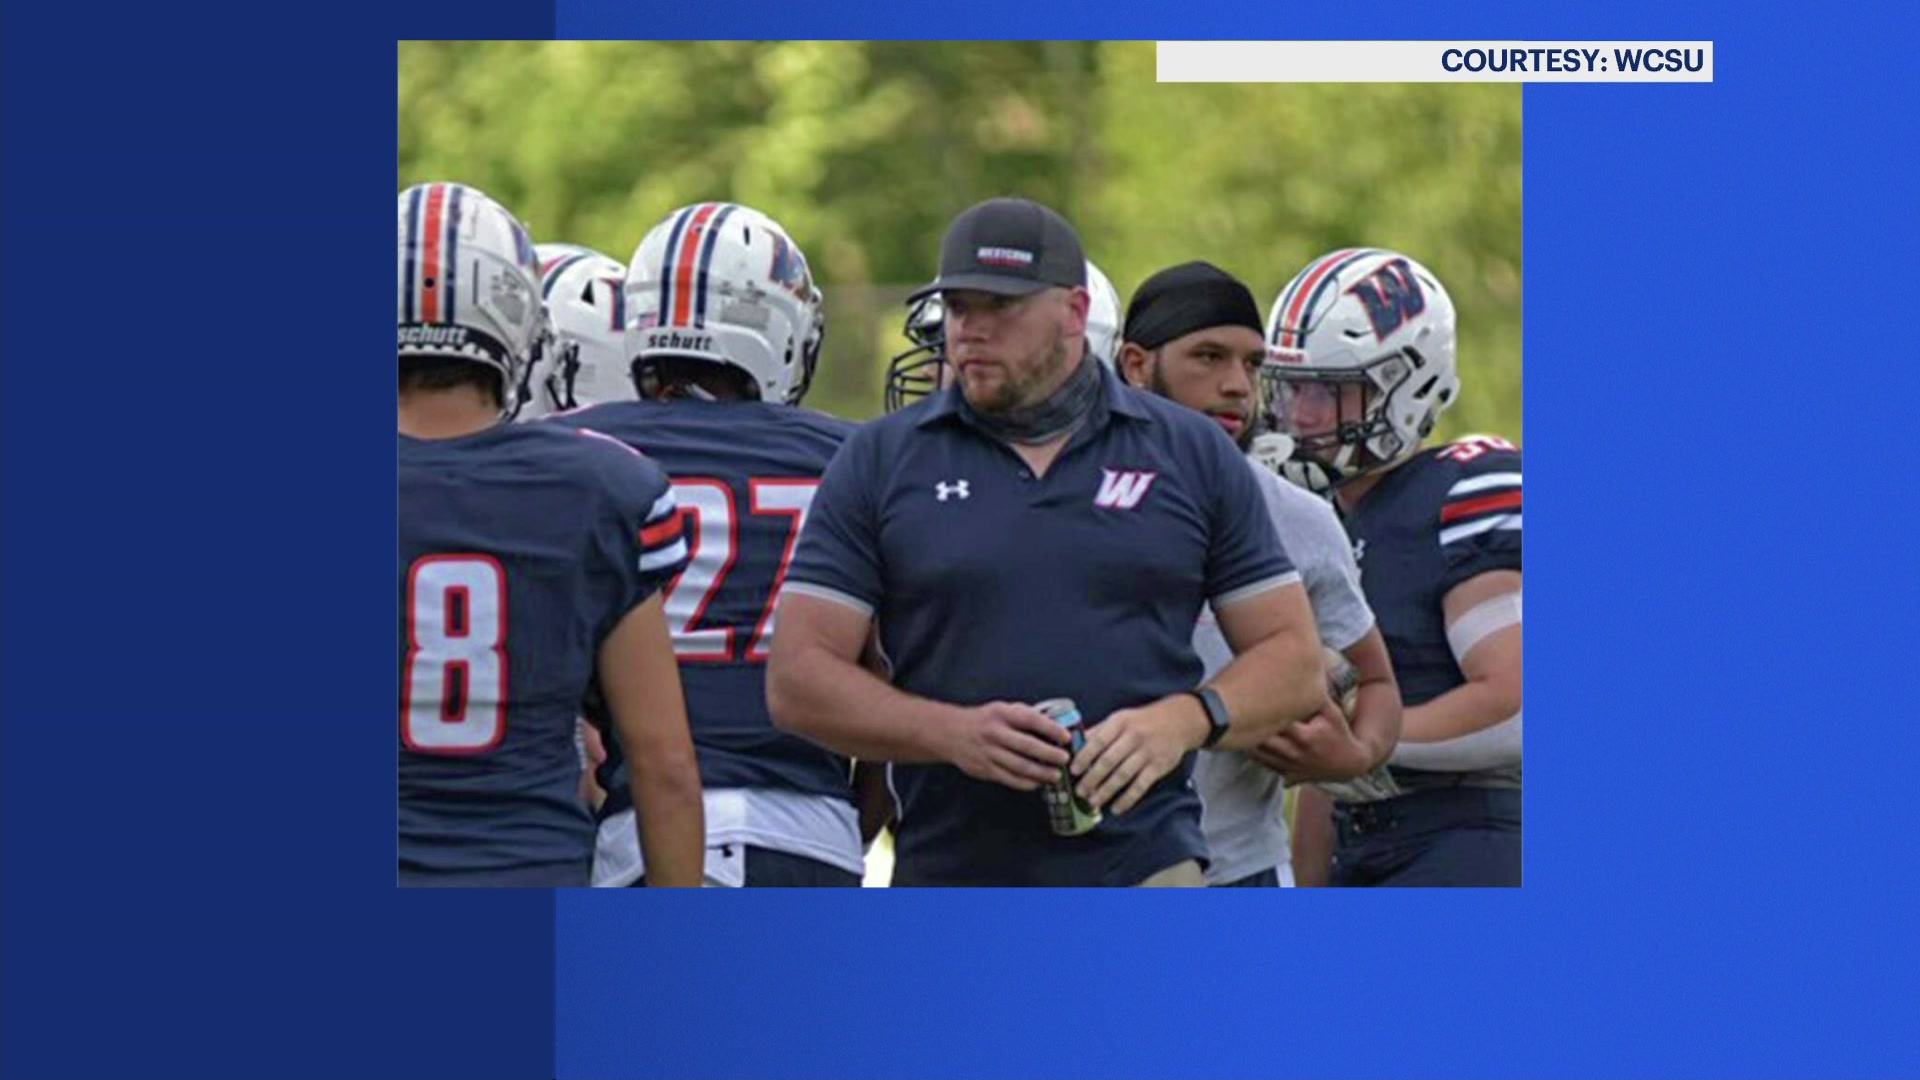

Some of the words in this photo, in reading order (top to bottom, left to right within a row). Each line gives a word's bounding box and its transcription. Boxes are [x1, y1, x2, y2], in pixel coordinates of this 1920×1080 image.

[1343, 257, 1426, 344] W
[647, 331, 713, 351] schutt
[1093, 466, 1156, 510] W
[402, 553, 508, 755] 8
